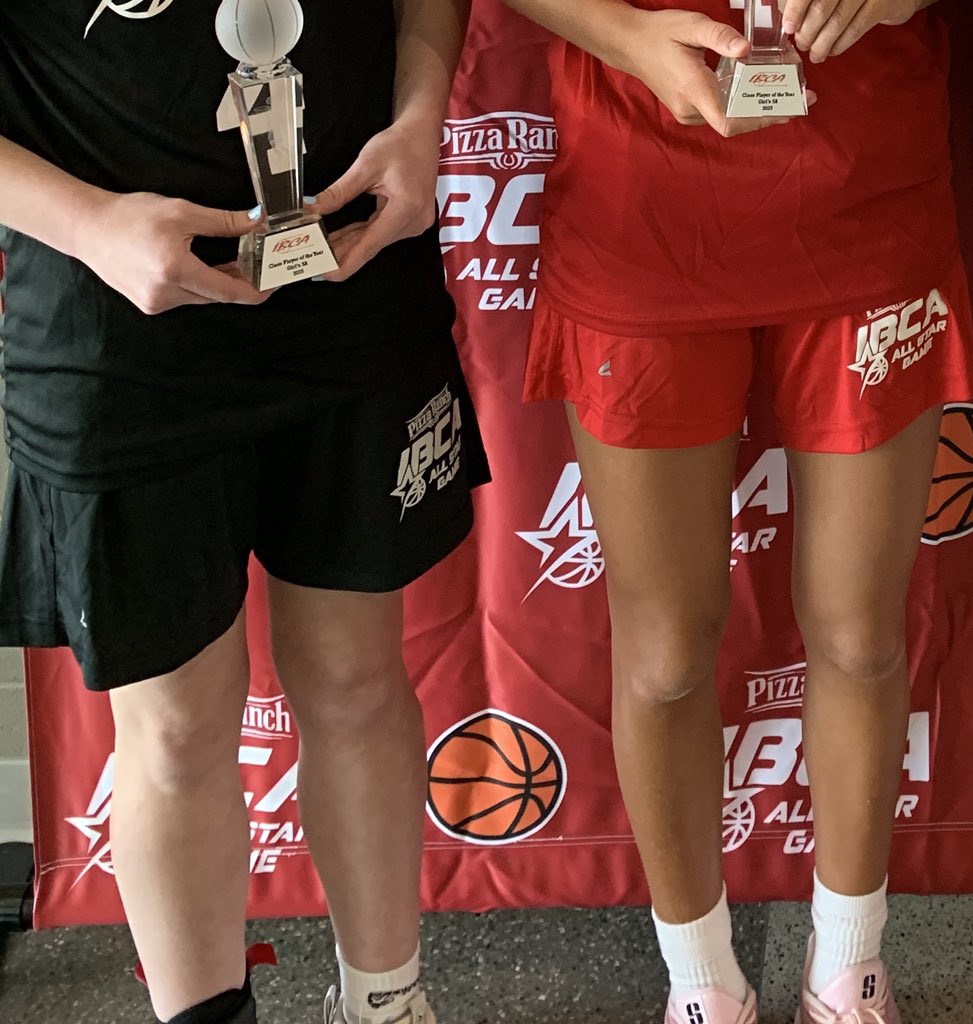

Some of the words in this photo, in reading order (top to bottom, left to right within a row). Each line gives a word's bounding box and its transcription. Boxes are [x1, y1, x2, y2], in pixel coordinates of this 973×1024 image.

[507, 119, 558, 152] Ran
[456, 258, 520, 281] ALL
[855, 288, 948, 363] IBCA
[891, 342, 915, 363] ALL
[917, 320, 947, 347] STAR
[902, 337, 933, 370] GAME
[407, 408, 432, 438] Pizza
[397, 397, 462, 486] IBCA
[429, 460, 448, 485] ALL
[242, 701, 291, 733] nch
